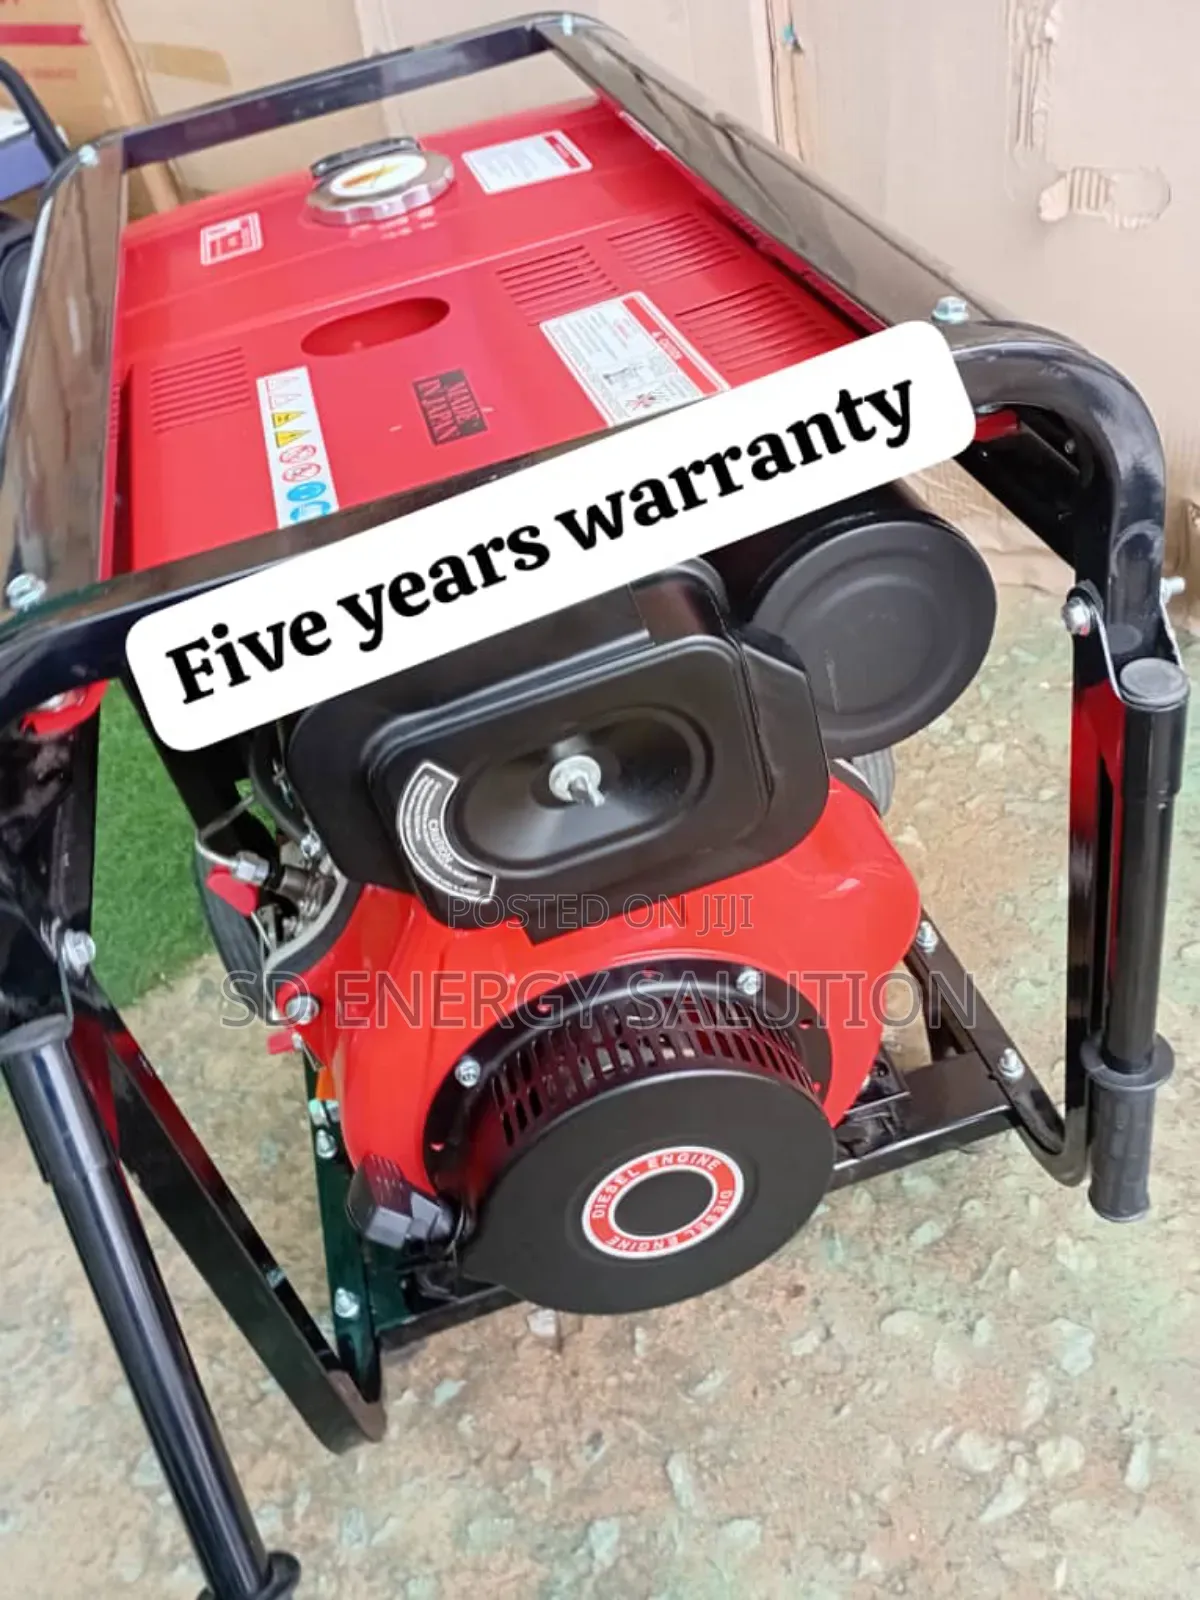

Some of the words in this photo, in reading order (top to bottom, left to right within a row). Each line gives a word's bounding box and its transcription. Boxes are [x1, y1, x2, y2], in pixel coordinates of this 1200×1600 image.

[591, 1168, 641, 1219] DIESEL
[647, 1152, 720, 1170] ENGINE
[684, 1190, 734, 1238] DIESEL
[606, 1235, 679, 1252] ENGINE
